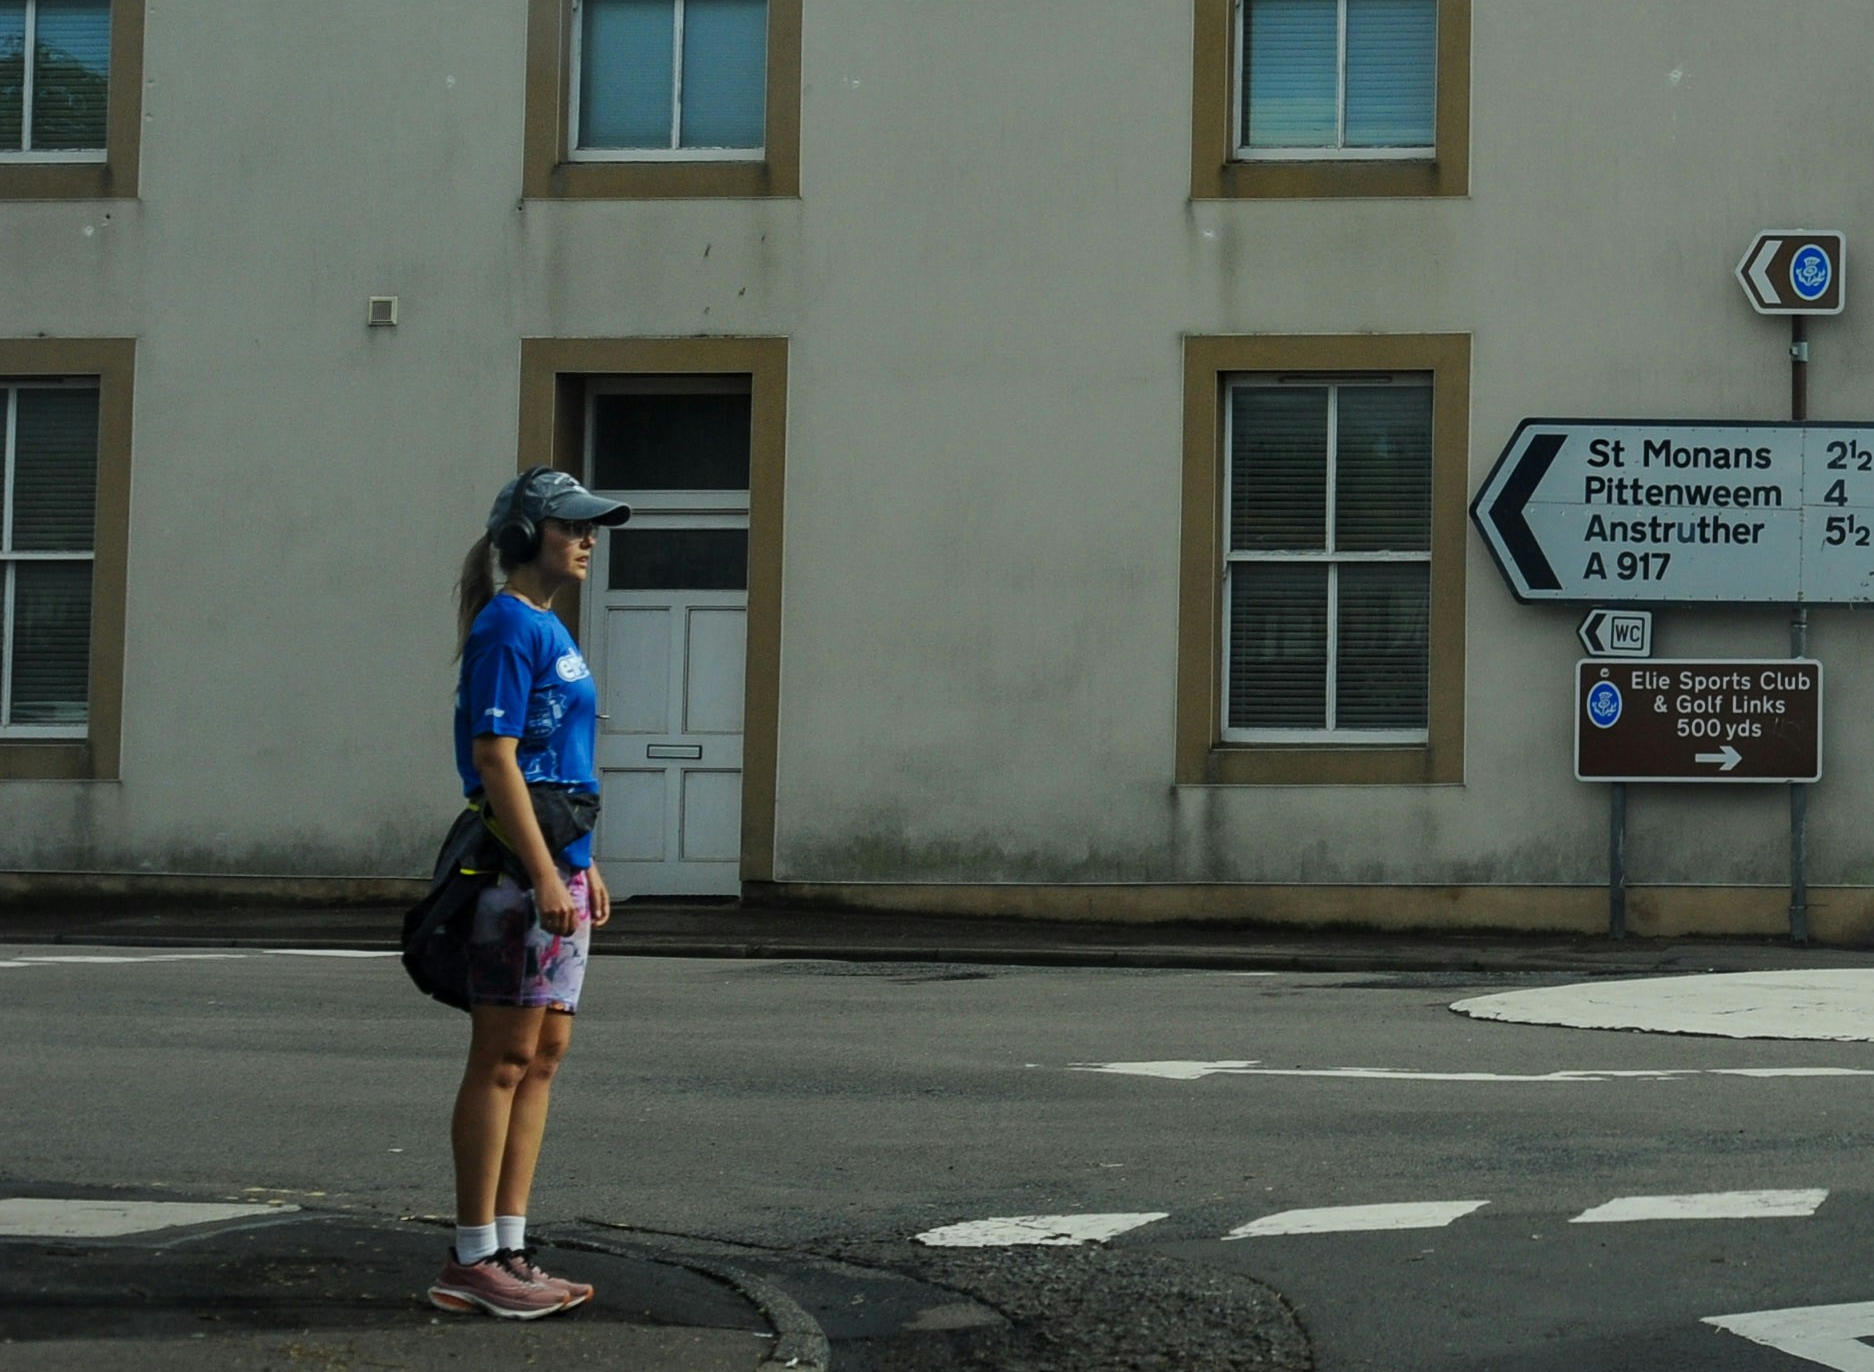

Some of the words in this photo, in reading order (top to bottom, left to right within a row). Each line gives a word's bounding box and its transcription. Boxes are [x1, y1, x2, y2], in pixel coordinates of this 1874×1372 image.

[1587, 439, 1626, 468] St
[1643, 440, 1772, 469] Monans
[1584, 476, 1782, 507] Pittenweem
[1824, 479, 1848, 506] 4
[1584, 516, 1765, 544] Anstruther
[1583, 553, 1607, 580] A
[1616, 552, 1670, 581] 917
[1615, 624, 1640, 642] WC
[1631, 671, 1670, 690] Elie
[1679, 672, 1750, 694] Sports
[1760, 671, 1810, 690] Club
[1653, 695, 1668, 713] &
[1676, 694, 1722, 713] Golf
[1732, 695, 1785, 713] Links
[1677, 719, 1720, 737] 500
[1726, 719, 1762, 741] yds
